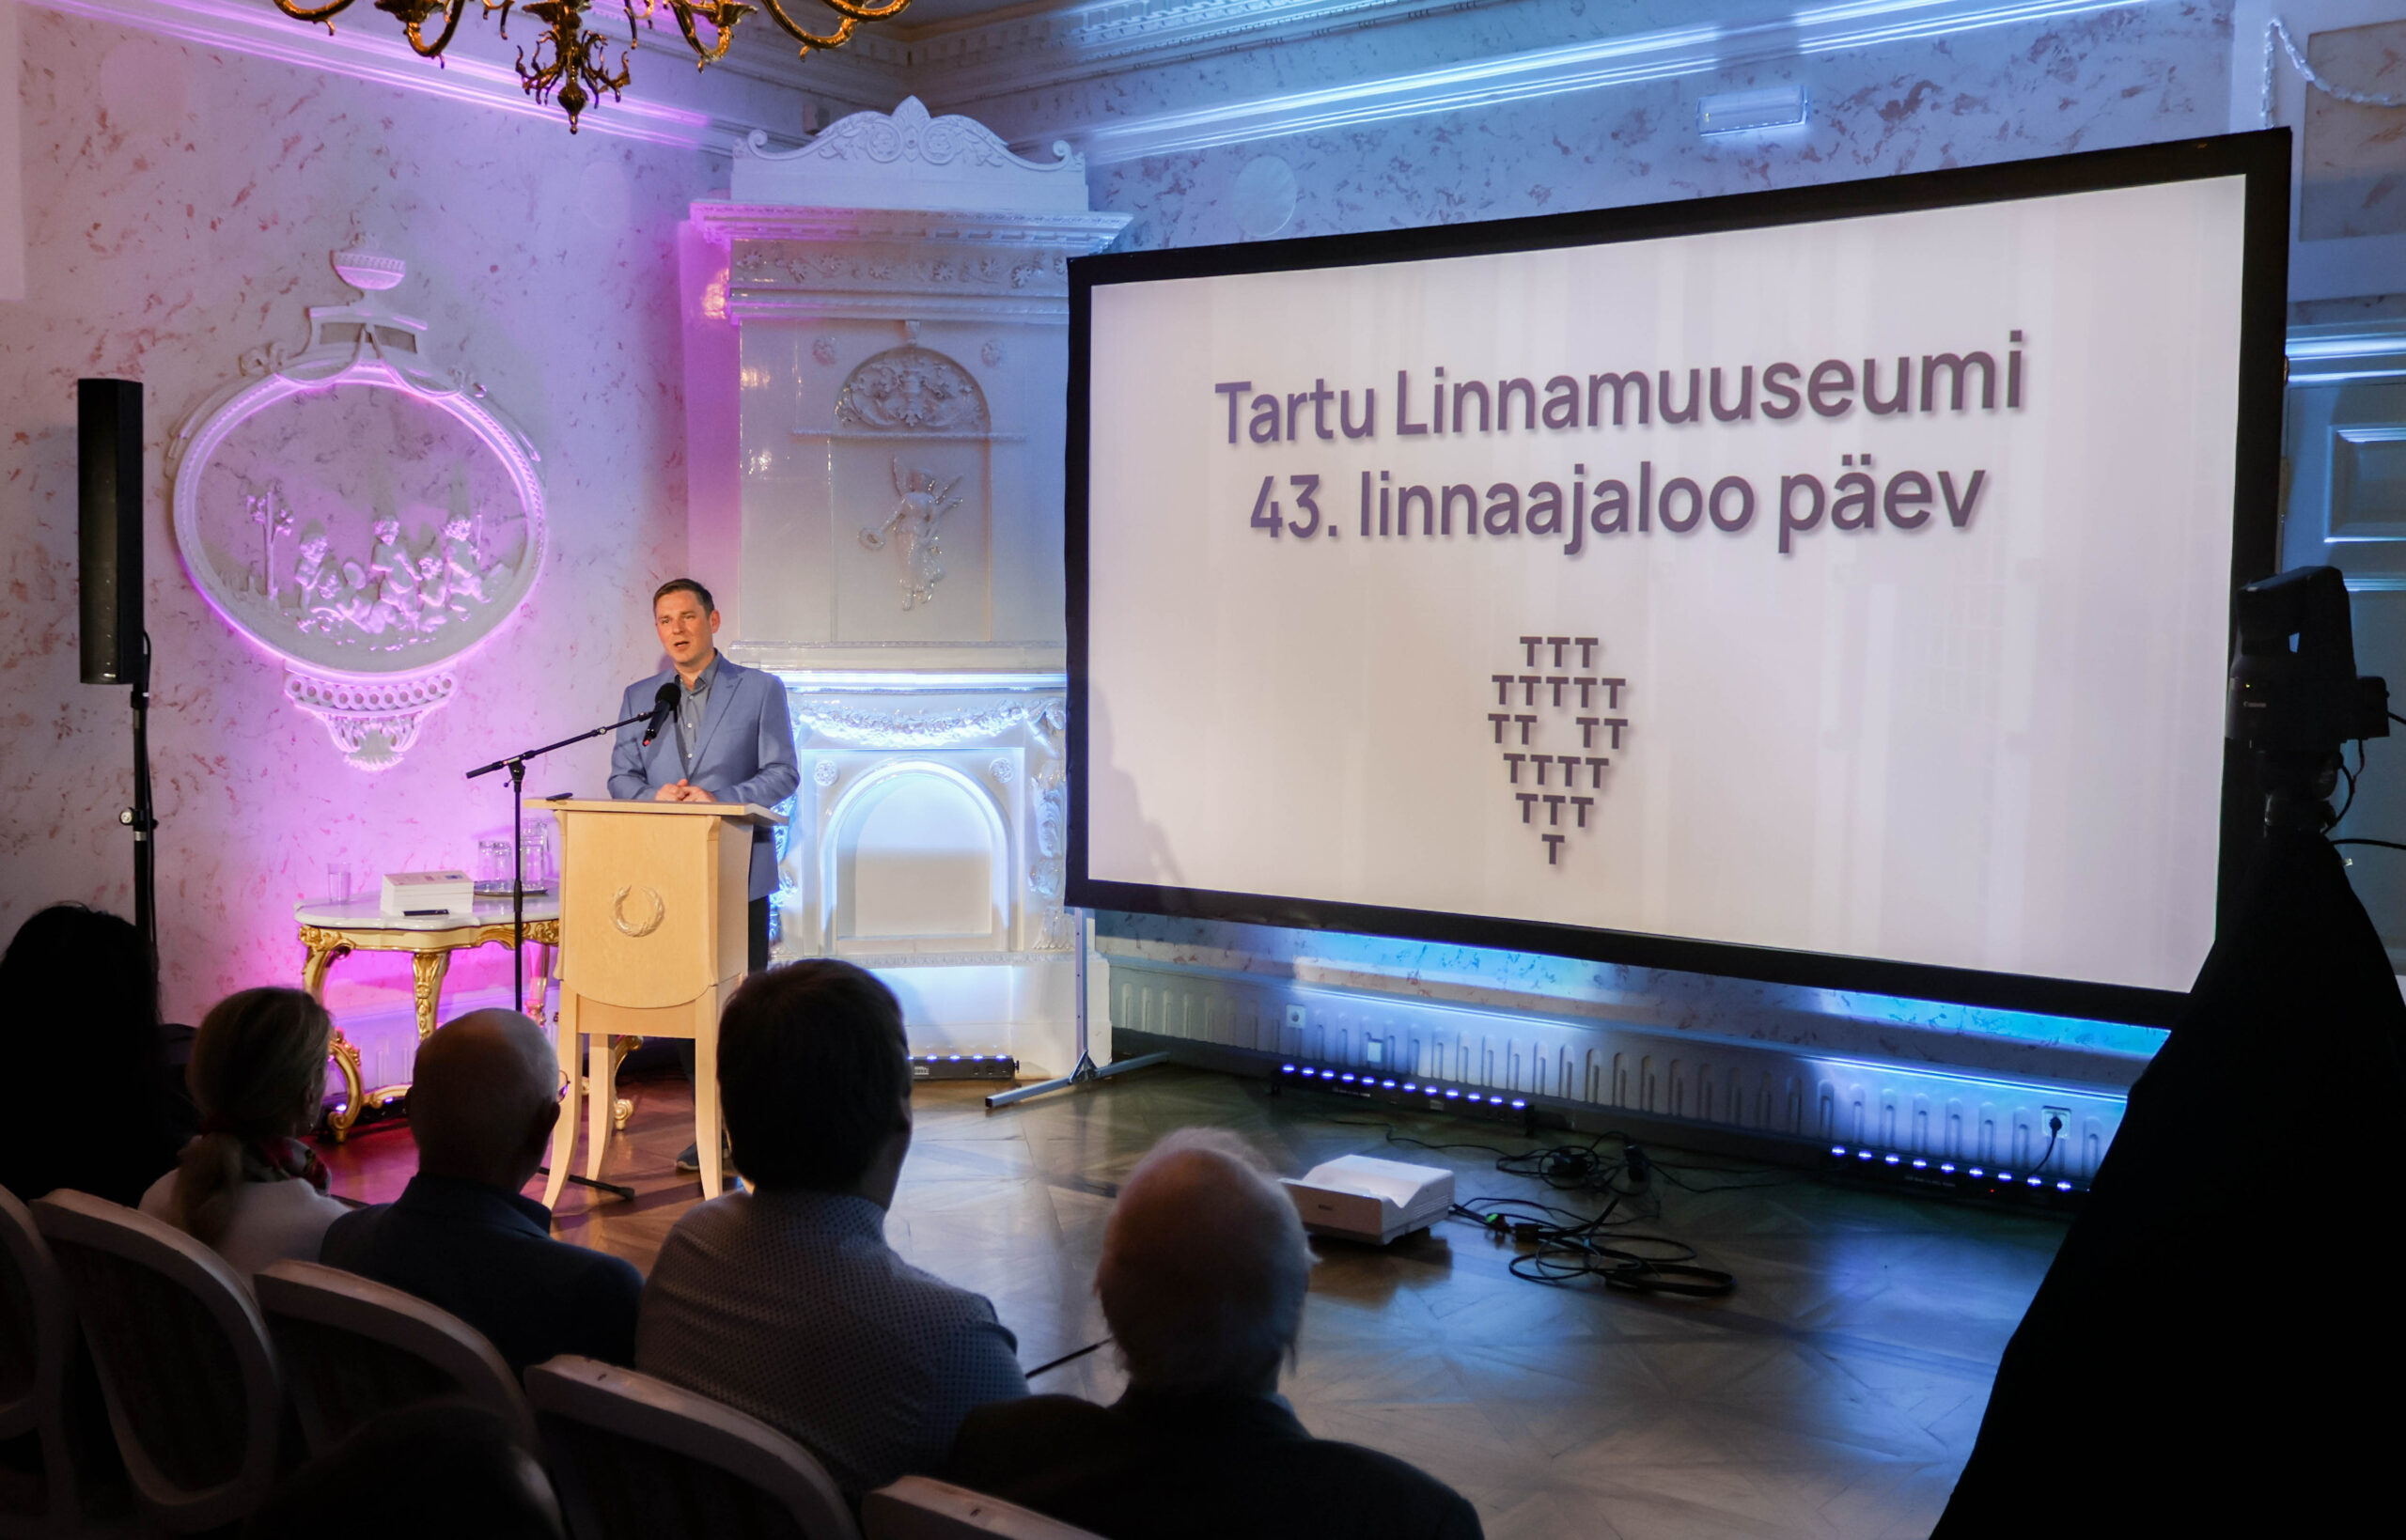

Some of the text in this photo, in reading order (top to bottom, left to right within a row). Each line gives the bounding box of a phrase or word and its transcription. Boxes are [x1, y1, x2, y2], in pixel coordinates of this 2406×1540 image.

[1214, 329, 2024, 444] Tartu Linnamuuseumi
[1250, 453, 1988, 557] 43. linnaajaloo päev
